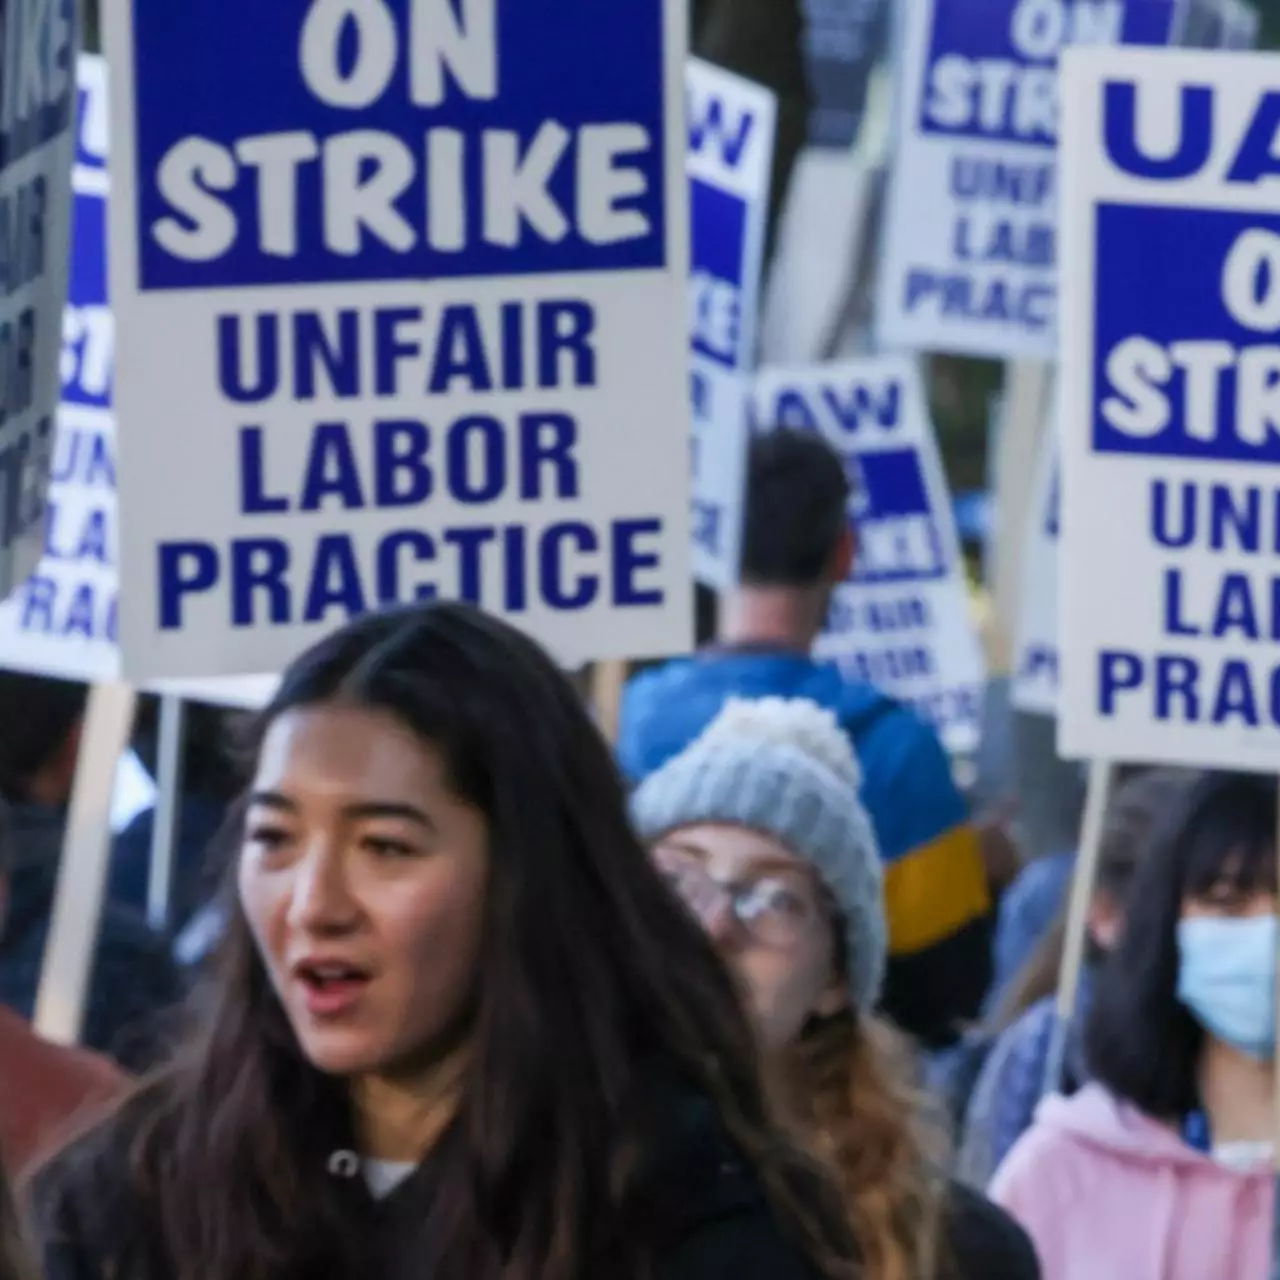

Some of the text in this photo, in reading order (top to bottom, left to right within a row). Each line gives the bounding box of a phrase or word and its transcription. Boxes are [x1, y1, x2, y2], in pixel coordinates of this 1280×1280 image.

[300, 0, 498, 108] ON
[926, 54, 1057, 141] STR
[152, 120, 651, 261] STRIKE
[952, 156, 1055, 205] UNF
[955, 215, 1057, 262] LAB
[905, 270, 1057, 327] PRAC
[217, 300, 597, 403] UNFAIR
[777, 379, 900, 432] AW
[239, 411, 580, 514] LABOR
[156, 519, 664, 630] PRACTICE
